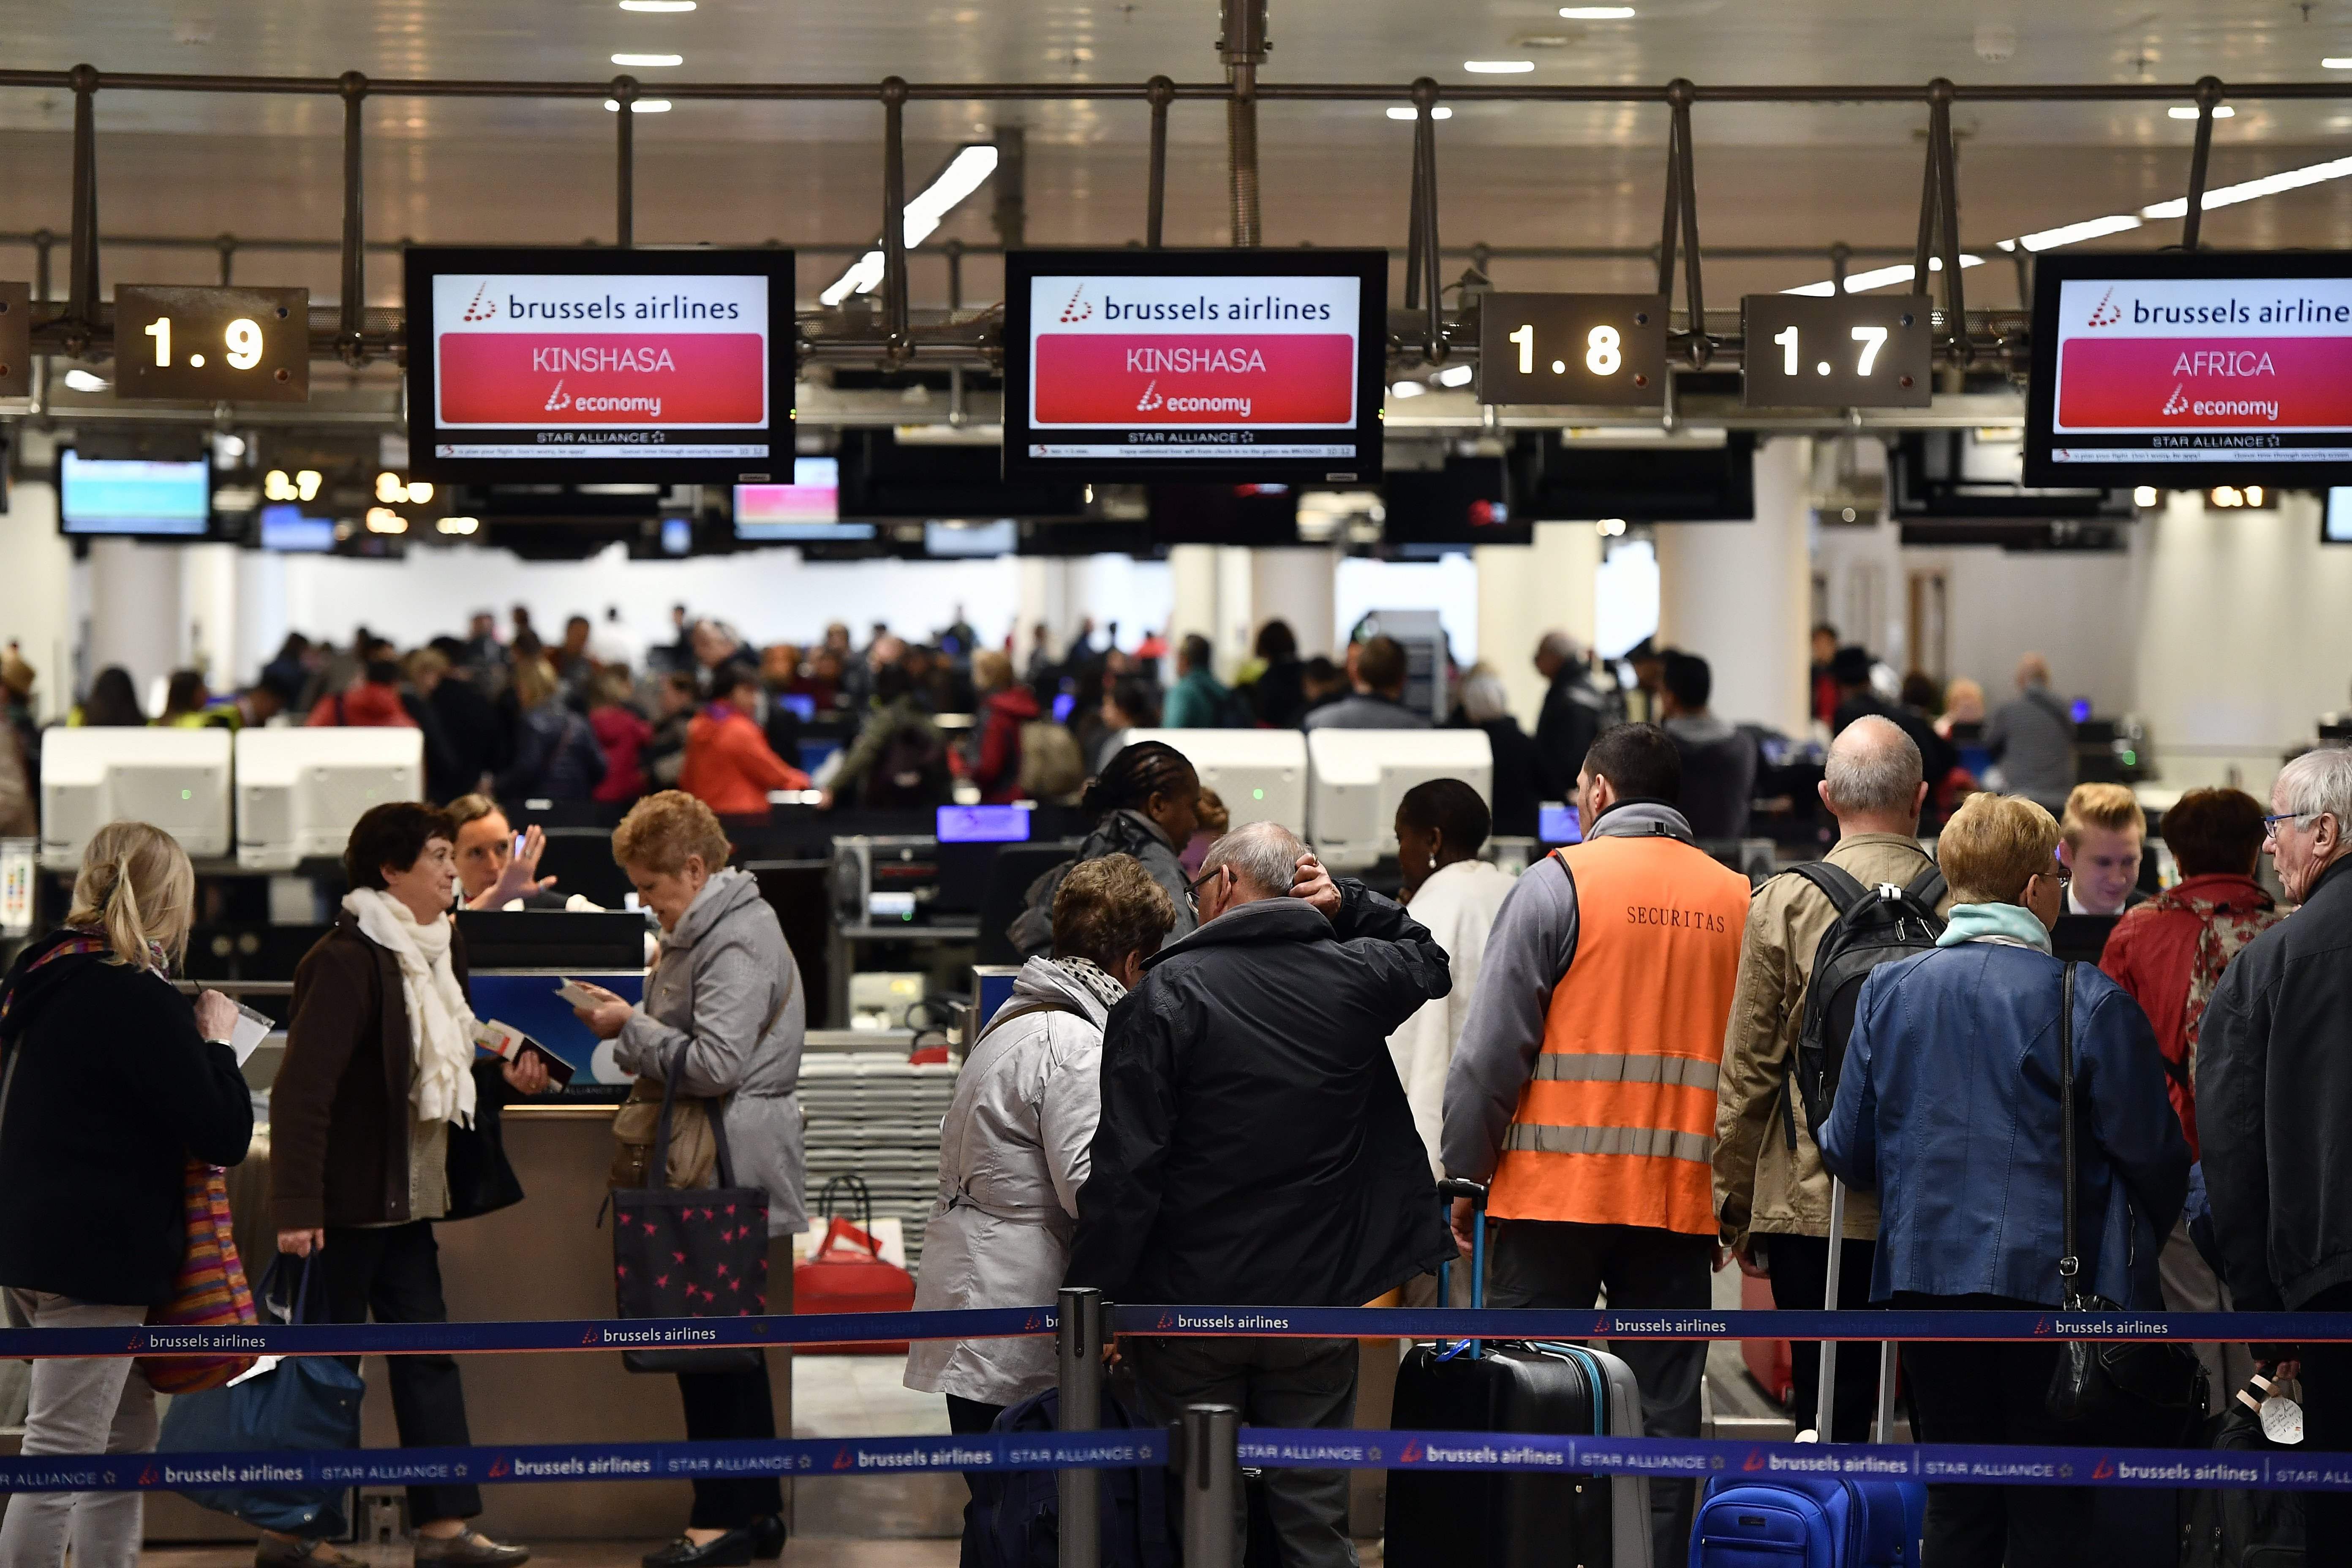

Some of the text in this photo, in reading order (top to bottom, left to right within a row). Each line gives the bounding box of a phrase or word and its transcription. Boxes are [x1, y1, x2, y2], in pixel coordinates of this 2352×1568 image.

[510, 295, 738, 319] brussels airlines
[1106, 296, 1329, 320] brussels airlines
[2134, 299, 2349, 323] brussels airline
[145, 318, 263, 370] 1.9
[1510, 325, 1621, 376] 1.8
[1775, 327, 1887, 376] 1.7
[534, 347, 675, 372] KINSHASA
[1127, 348, 1266, 373] KINSHASA
[2173, 351, 2275, 376] AFRICA
[576, 397, 661, 416] economy
[1167, 398, 1250, 417] economy
[2194, 401, 2278, 420] economy
[537, 433, 648, 443] STAR ALLIANCE
[1129, 433, 1237, 443] STAR ALLIANCE
[2153, 436, 2264, 448] STAR ALLIANCE
[1628, 907, 1724, 933] SECURITAS
[1179, 1315, 1288, 1328] brussels airlines
[1616, 1319, 1726, 1331] brussels airlines
[2056, 1320, 2167, 1333] brussels airlines
[151, 1334, 265, 1347] brussels airlines
[604, 1327, 715, 1342] brussels airlines
[17, 1473, 95, 1485] ALLIANCE
[166, 1465, 236, 1482] brussels
[240, 1465, 302, 1481] airlines
[322, 1467, 363, 1479] STAR
[369, 1465, 447, 1478] ALLIANCE
[515, 1458, 584, 1475] brussels
[588, 1458, 650, 1473] airlines
[669, 1459, 709, 1471] STAR
[715, 1457, 792, 1470] ALLIANCE
[859, 1451, 927, 1467] brussels
[931, 1449, 992, 1465] airlines
[1010, 1450, 1051, 1463] STAR
[1055, 1448, 1132, 1462] ALLIANCE
[1239, 1445, 1277, 1458] STAR
[1282, 1448, 1362, 1460] ALLIANCE
[1427, 1446, 1497, 1463] brussels
[1501, 1447, 1563, 1465] airlines
[1581, 1454, 1622, 1465] STAR
[1627, 1456, 1705, 1468] ALLIANCE
[1769, 1455, 1840, 1471] brussels
[1843, 1457, 1907, 1473] airlines
[1925, 1462, 1968, 1474] STAR
[1972, 1464, 2053, 1476] ALLIANCE
[2119, 1463, 2190, 1479] brussels
[2194, 1465, 2257, 1481] airlines
[2276, 1470, 2317, 1481] STAR
